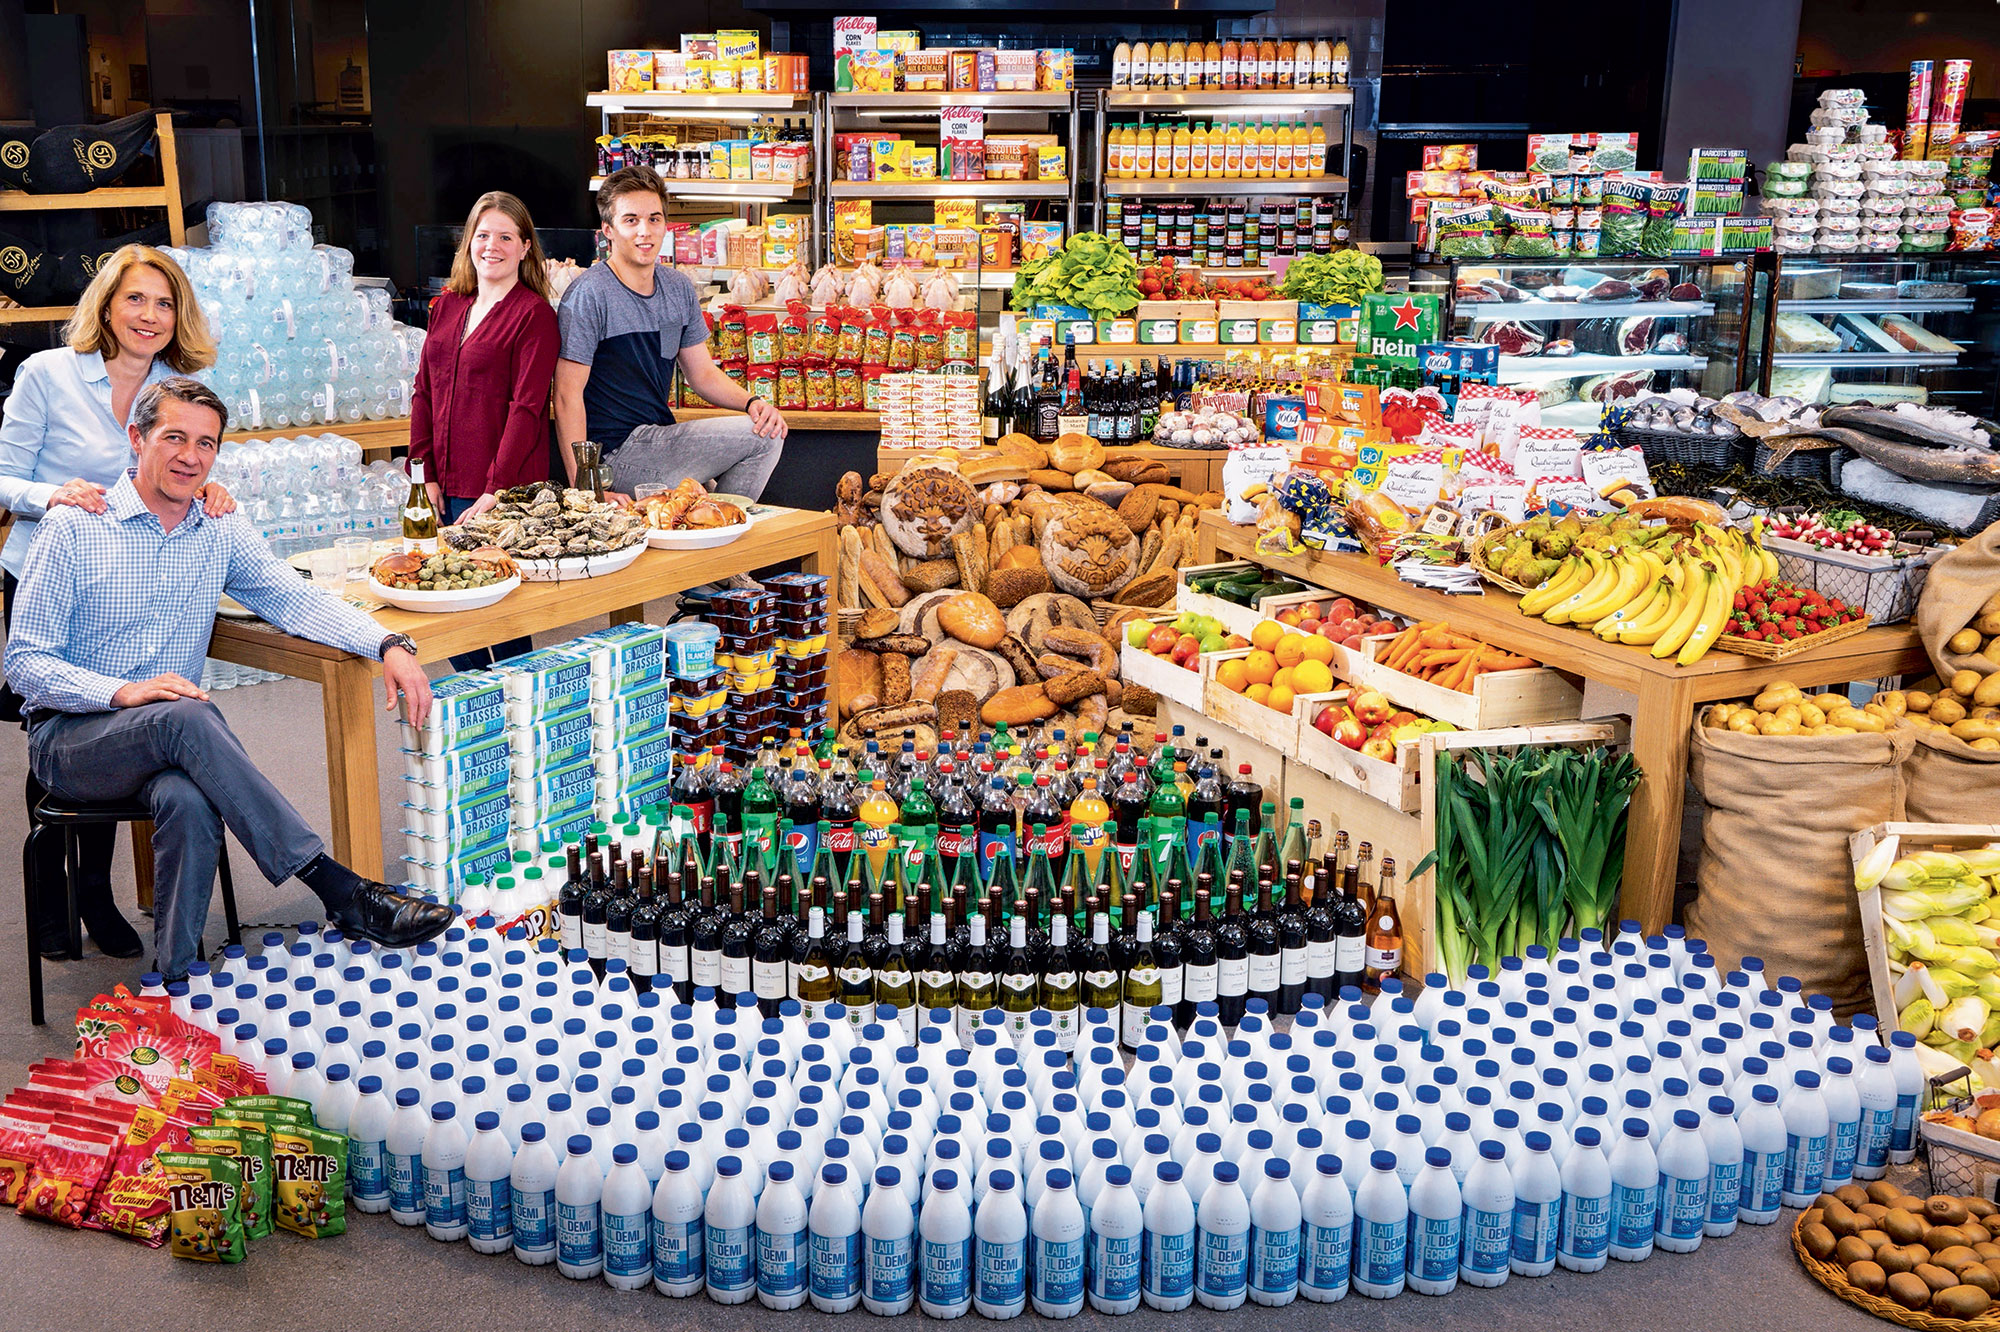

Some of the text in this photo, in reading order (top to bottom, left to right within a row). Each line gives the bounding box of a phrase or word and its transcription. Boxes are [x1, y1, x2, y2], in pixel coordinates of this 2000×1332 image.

[724, 42, 757, 58] Nesquik
[907, 56, 944, 64] BISCOTTES
[998, 56, 1034, 64] BISCOTTES
[986, 146, 1020, 154] BISCOTTES
[754, 339, 769, 350] BIO
[950, 334, 966, 345] BIO
[1372, 338, 1417, 357] Hein
[756, 384, 772, 395] BIO
[1306, 390, 1317, 406] LU
[1303, 428, 1315, 443] LU
[1525, 441, 1577, 453] Bonne Maman
[625, 640, 660, 660] 16 YAOURTS
[625, 654, 660, 674] BRASSES
[549, 664, 587, 686] 16 YAOURTS
[549, 678, 587, 700] BRASSES
[459, 691, 500, 714] 16 YAOURTS
[629, 690, 664, 710] 16 YAOURTS
[460, 705, 501, 729] BRASSES
[630, 704, 665, 724] BRASSES
[550, 716, 588, 738] 16 YAOURTS
[551, 729, 589, 752] BRASSES
[464, 744, 506, 769] 16 YAOURTS
[631, 739, 667, 760] 16 YAOURTS
[464, 758, 507, 782] BRASSES
[633, 752, 668, 774] BRASSES
[552, 766, 590, 788] 16 YAOURTS
[553, 780, 591, 802] BRASSES
[464, 796, 507, 820] 16 YAOURTS
[466, 810, 507, 836] BRASSES
[865, 828, 888, 840] ANTA
[82, 1036, 107, 1058] Kr
[12, 1121, 41, 1131] MONOPRIX
[167, 1155, 209, 1166] LIMITED EDITION
[354, 1157, 374, 1168] DEMI
[391, 1170, 411, 1181] DEMI
[112, 1194, 154, 1206] Caramel
[469, 1196, 490, 1208] DEMI
[1623, 1189, 1644, 1203] LAIT
[1577, 1198, 1598, 1212] LAIT
[559, 1206, 574, 1219] LAIT
[1477, 1212, 1499, 1226] LAIT
[568, 1220, 591, 1232] DEMI
[606, 1216, 623, 1229] LAIT
[616, 1230, 640, 1242] DEMI
[708, 1229, 725, 1243] LAIT
[1207, 1234, 1228, 1249] LAIT
[1318, 1229, 1339, 1242] LAIT
[718, 1244, 742, 1256] DEMI
[927, 1242, 946, 1258] LAIT
[983, 1243, 1002, 1258] LAIT
[1107, 1238, 1128, 1252] LAIT
[1219, 1250, 1242, 1262] DEMI
[937, 1257, 961, 1271] DEMI
[994, 1259, 1018, 1271] DEMI
